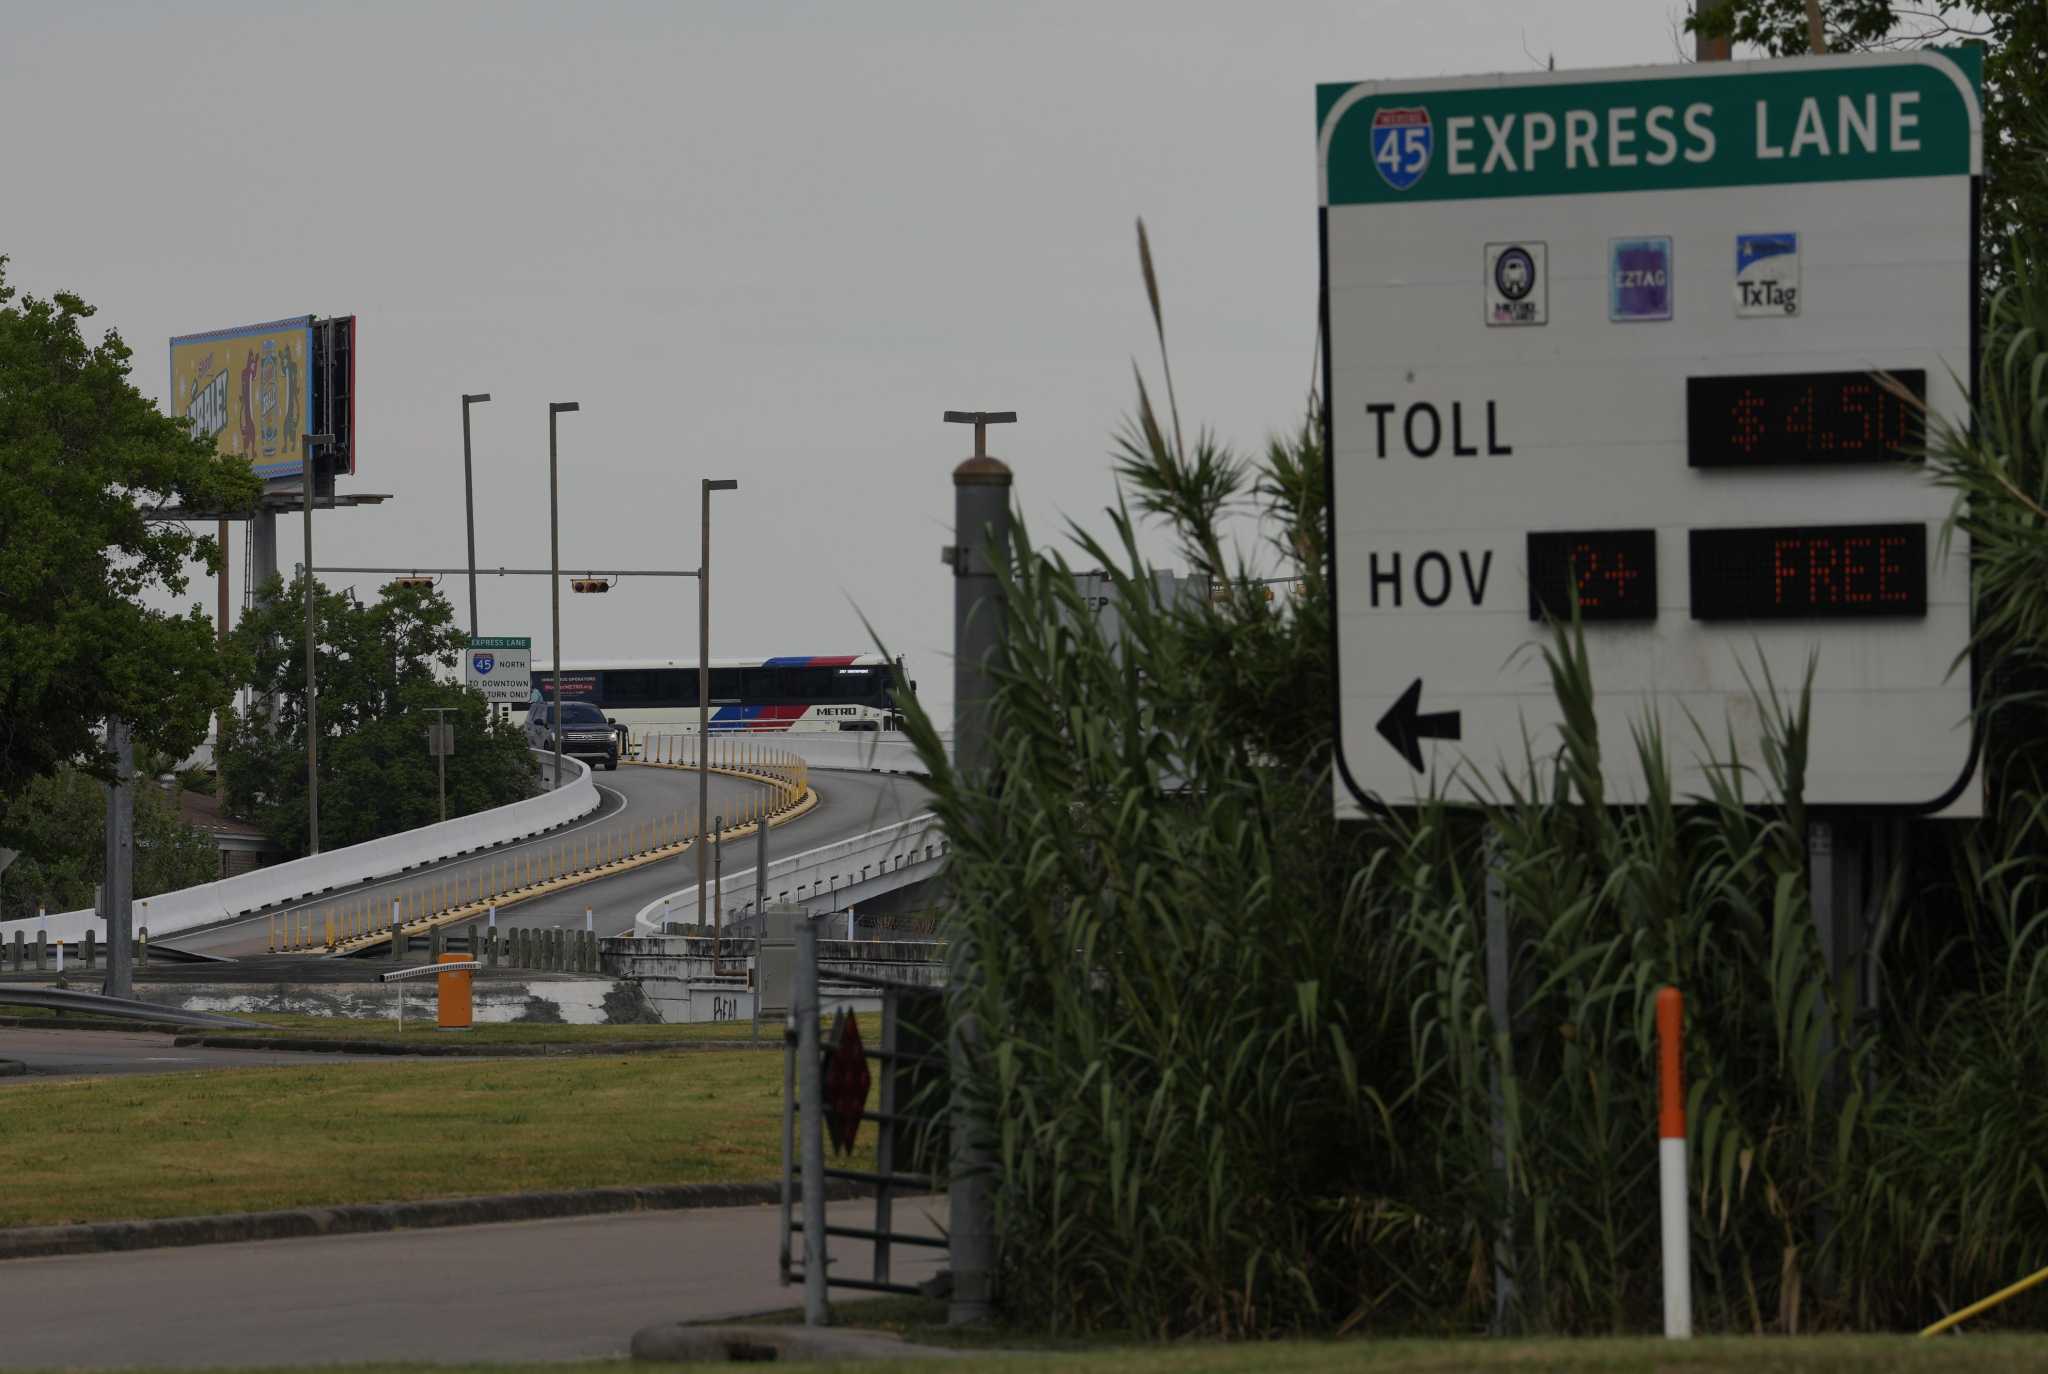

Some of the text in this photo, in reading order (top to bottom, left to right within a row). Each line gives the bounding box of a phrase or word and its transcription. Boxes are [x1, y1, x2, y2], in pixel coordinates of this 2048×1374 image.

[1377, 90, 1921, 176] 45 EXPRESS LANE
[1615, 269, 1666, 288] EZTAG
[1737, 280, 1796, 313] TxTag
[1366, 400, 1512, 458] TOLL
[1369, 549, 1492, 608] HOV
[1775, 536, 1908, 605] FREE
[471, 639, 526, 647] EXPRESS LANE
[476, 659, 491, 670] 45
[488, 690, 507, 698] TURN
[509, 690, 528, 698] ONLY
[816, 707, 857, 716] METRO
